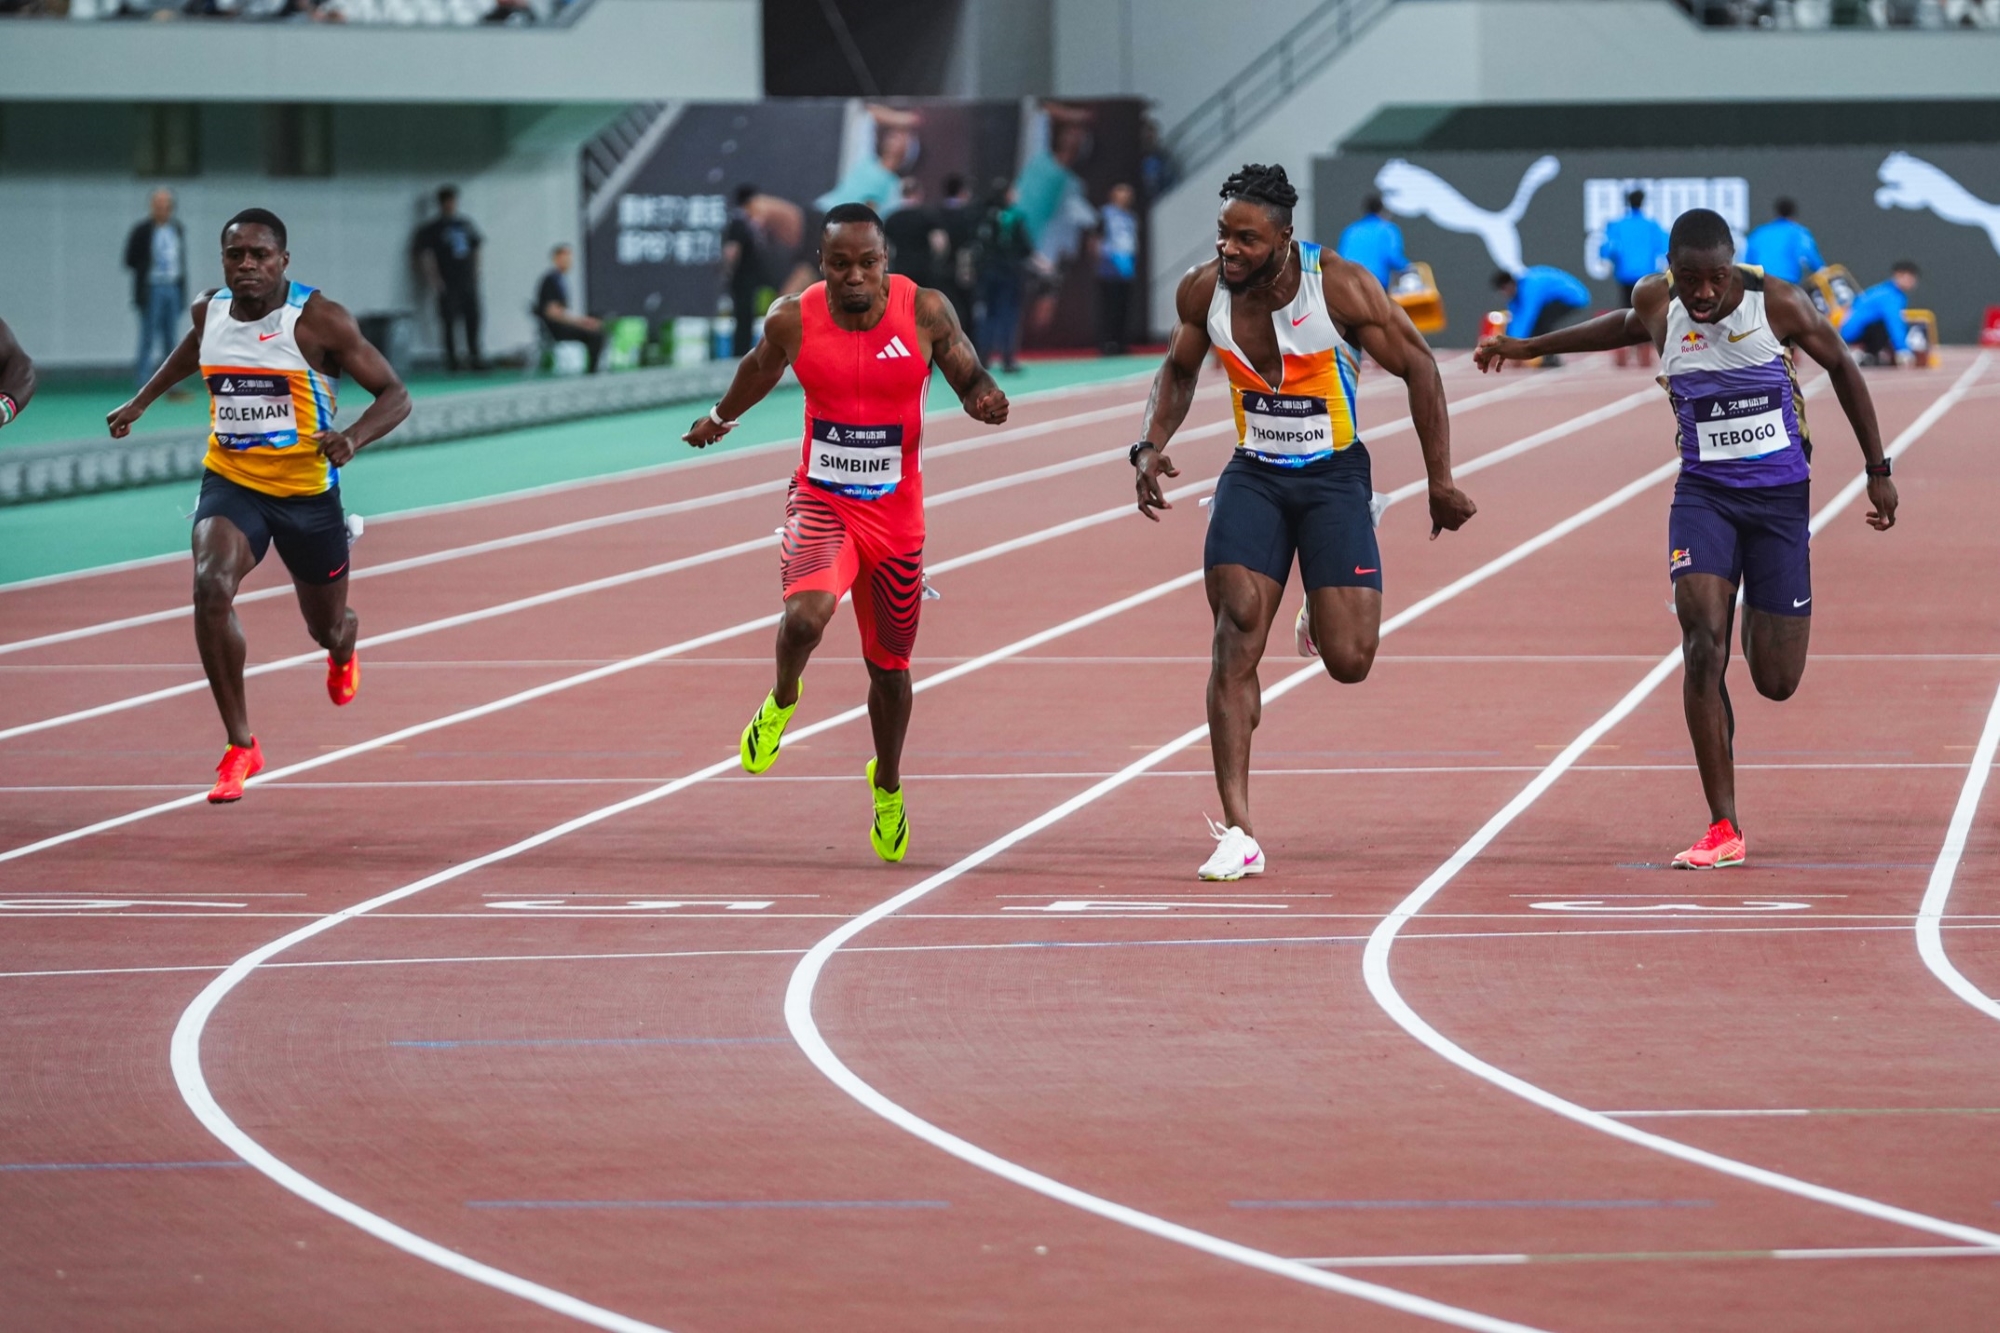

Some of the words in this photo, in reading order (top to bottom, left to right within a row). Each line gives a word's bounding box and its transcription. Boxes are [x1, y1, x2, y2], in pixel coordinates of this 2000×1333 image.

[218, 404, 289, 421] COLEMAN
[1251, 425, 1324, 442] THOMPSON
[1708, 423, 1776, 447] TEBOGO
[820, 453, 891, 472] SIMBINE
[484, 899, 775, 909] 5
[1000, 900, 1288, 911] 4
[1528, 901, 1812, 911] 3
